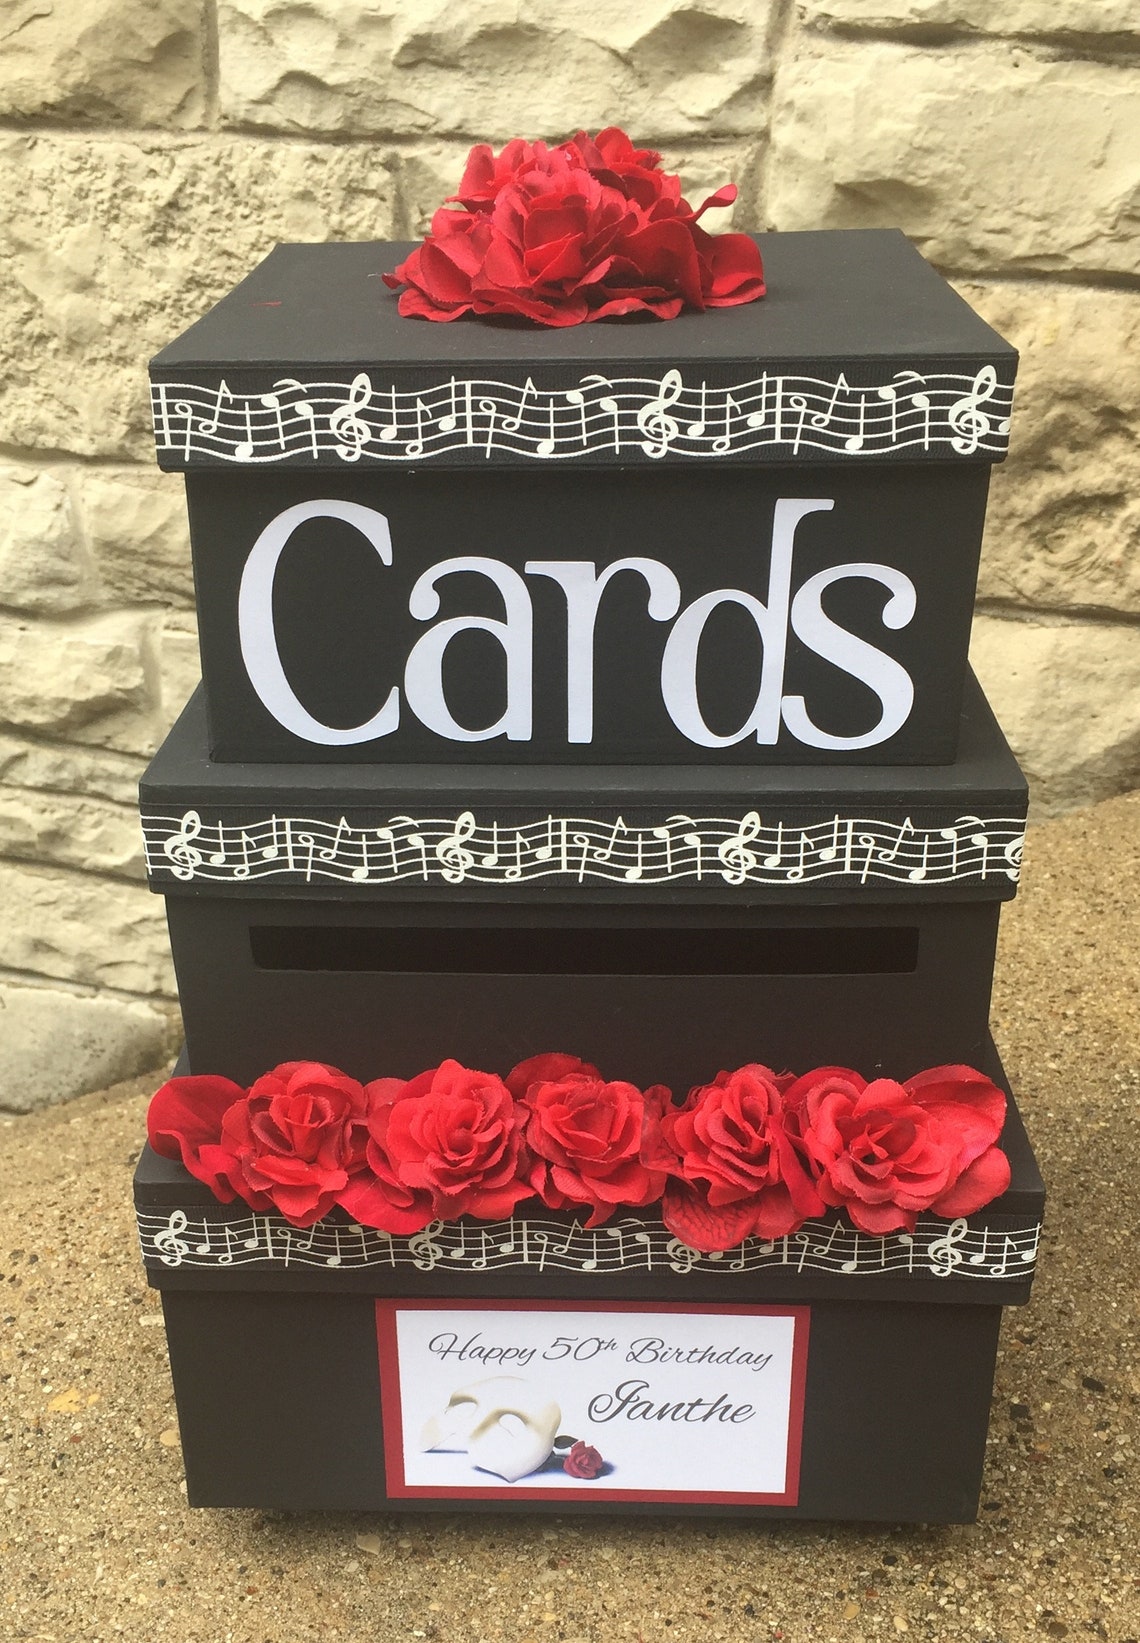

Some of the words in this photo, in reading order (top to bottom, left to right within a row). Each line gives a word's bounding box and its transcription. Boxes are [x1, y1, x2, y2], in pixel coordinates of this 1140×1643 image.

[238, 498, 917, 751] Cards
[428, 1331, 537, 1367] Happy
[542, 1336, 618, 1361] 50th
[625, 1337, 774, 1372] Birthday
[587, 1379, 757, 1424] Ianthe
